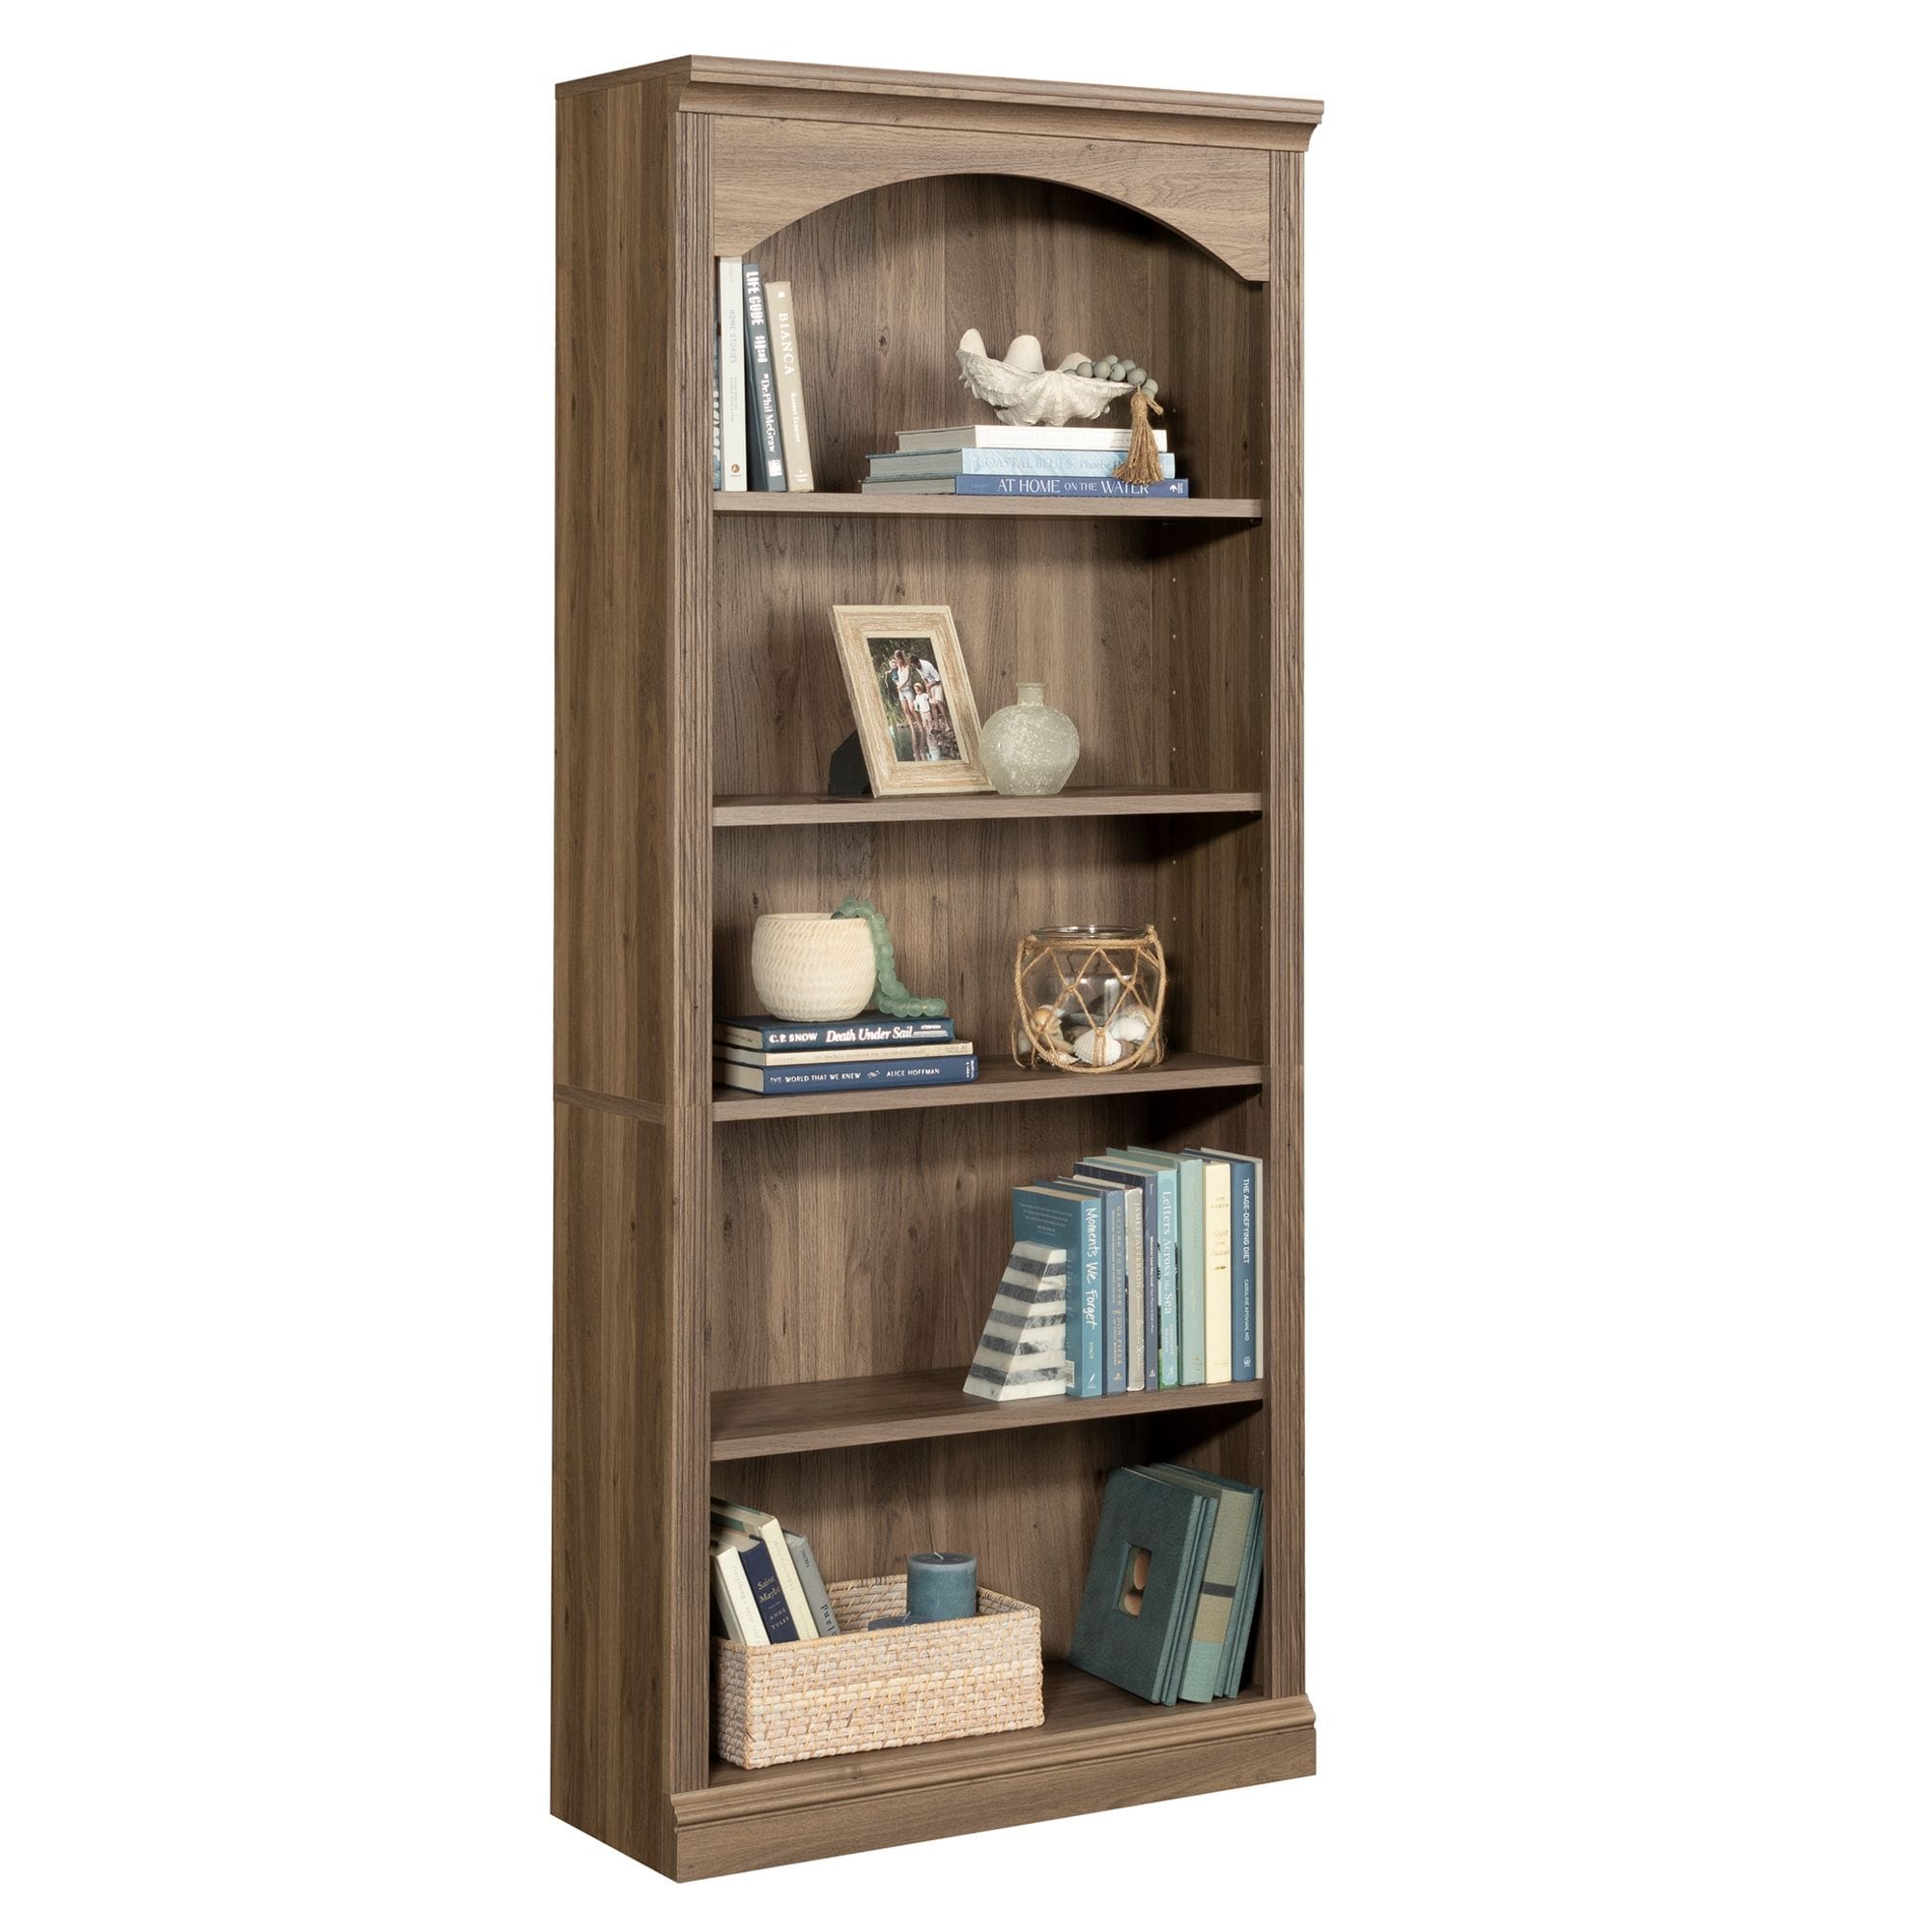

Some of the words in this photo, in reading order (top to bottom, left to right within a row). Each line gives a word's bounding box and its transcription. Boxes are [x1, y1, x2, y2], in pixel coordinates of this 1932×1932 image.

[746, 271, 760, 295] LIFE
[728, 309, 737, 330] HOME
[749, 296, 764, 326] CODE
[728, 331, 737, 364] STORIES
[779, 313, 795, 375] BIANCA
[764, 414, 777, 452] McGraw
[976, 457, 1032, 469] COASTAL
[1036, 458, 1073, 470] BLUES
[1079, 459, 1112, 469] Phoebe
[997, 479, 1015, 494] AT
[1018, 479, 1061, 494] HOME
[1064, 482, 1078, 491] ON
[1079, 482, 1097, 492] THE
[1100, 480, 1150, 495] WATER
[788, 1032, 818, 1043] SNOW
[825, 1029, 857, 1043] Death
[858, 1027, 892, 1041] Under
[892, 1025, 913, 1039] Sail
[784, 1074, 810, 1083] WORLD
[841, 1071, 862, 1080] KNEW
[907, 1067, 940, 1076] HOFFMAN
[1162, 1190, 1173, 1236] Letters
[1085, 1207, 1101, 1258] Moments
[1163, 1238, 1172, 1277] Across
[1085, 1262, 1098, 1284] We
[1083, 1288, 1098, 1330] Forget
[1164, 1293, 1173, 1315] Sea
[1244, 1333, 1250, 1342] MD
[757, 1575, 777, 1591] Saint
[758, 1585, 782, 1604] Maybe
[769, 1607, 787, 1620] ANNE
